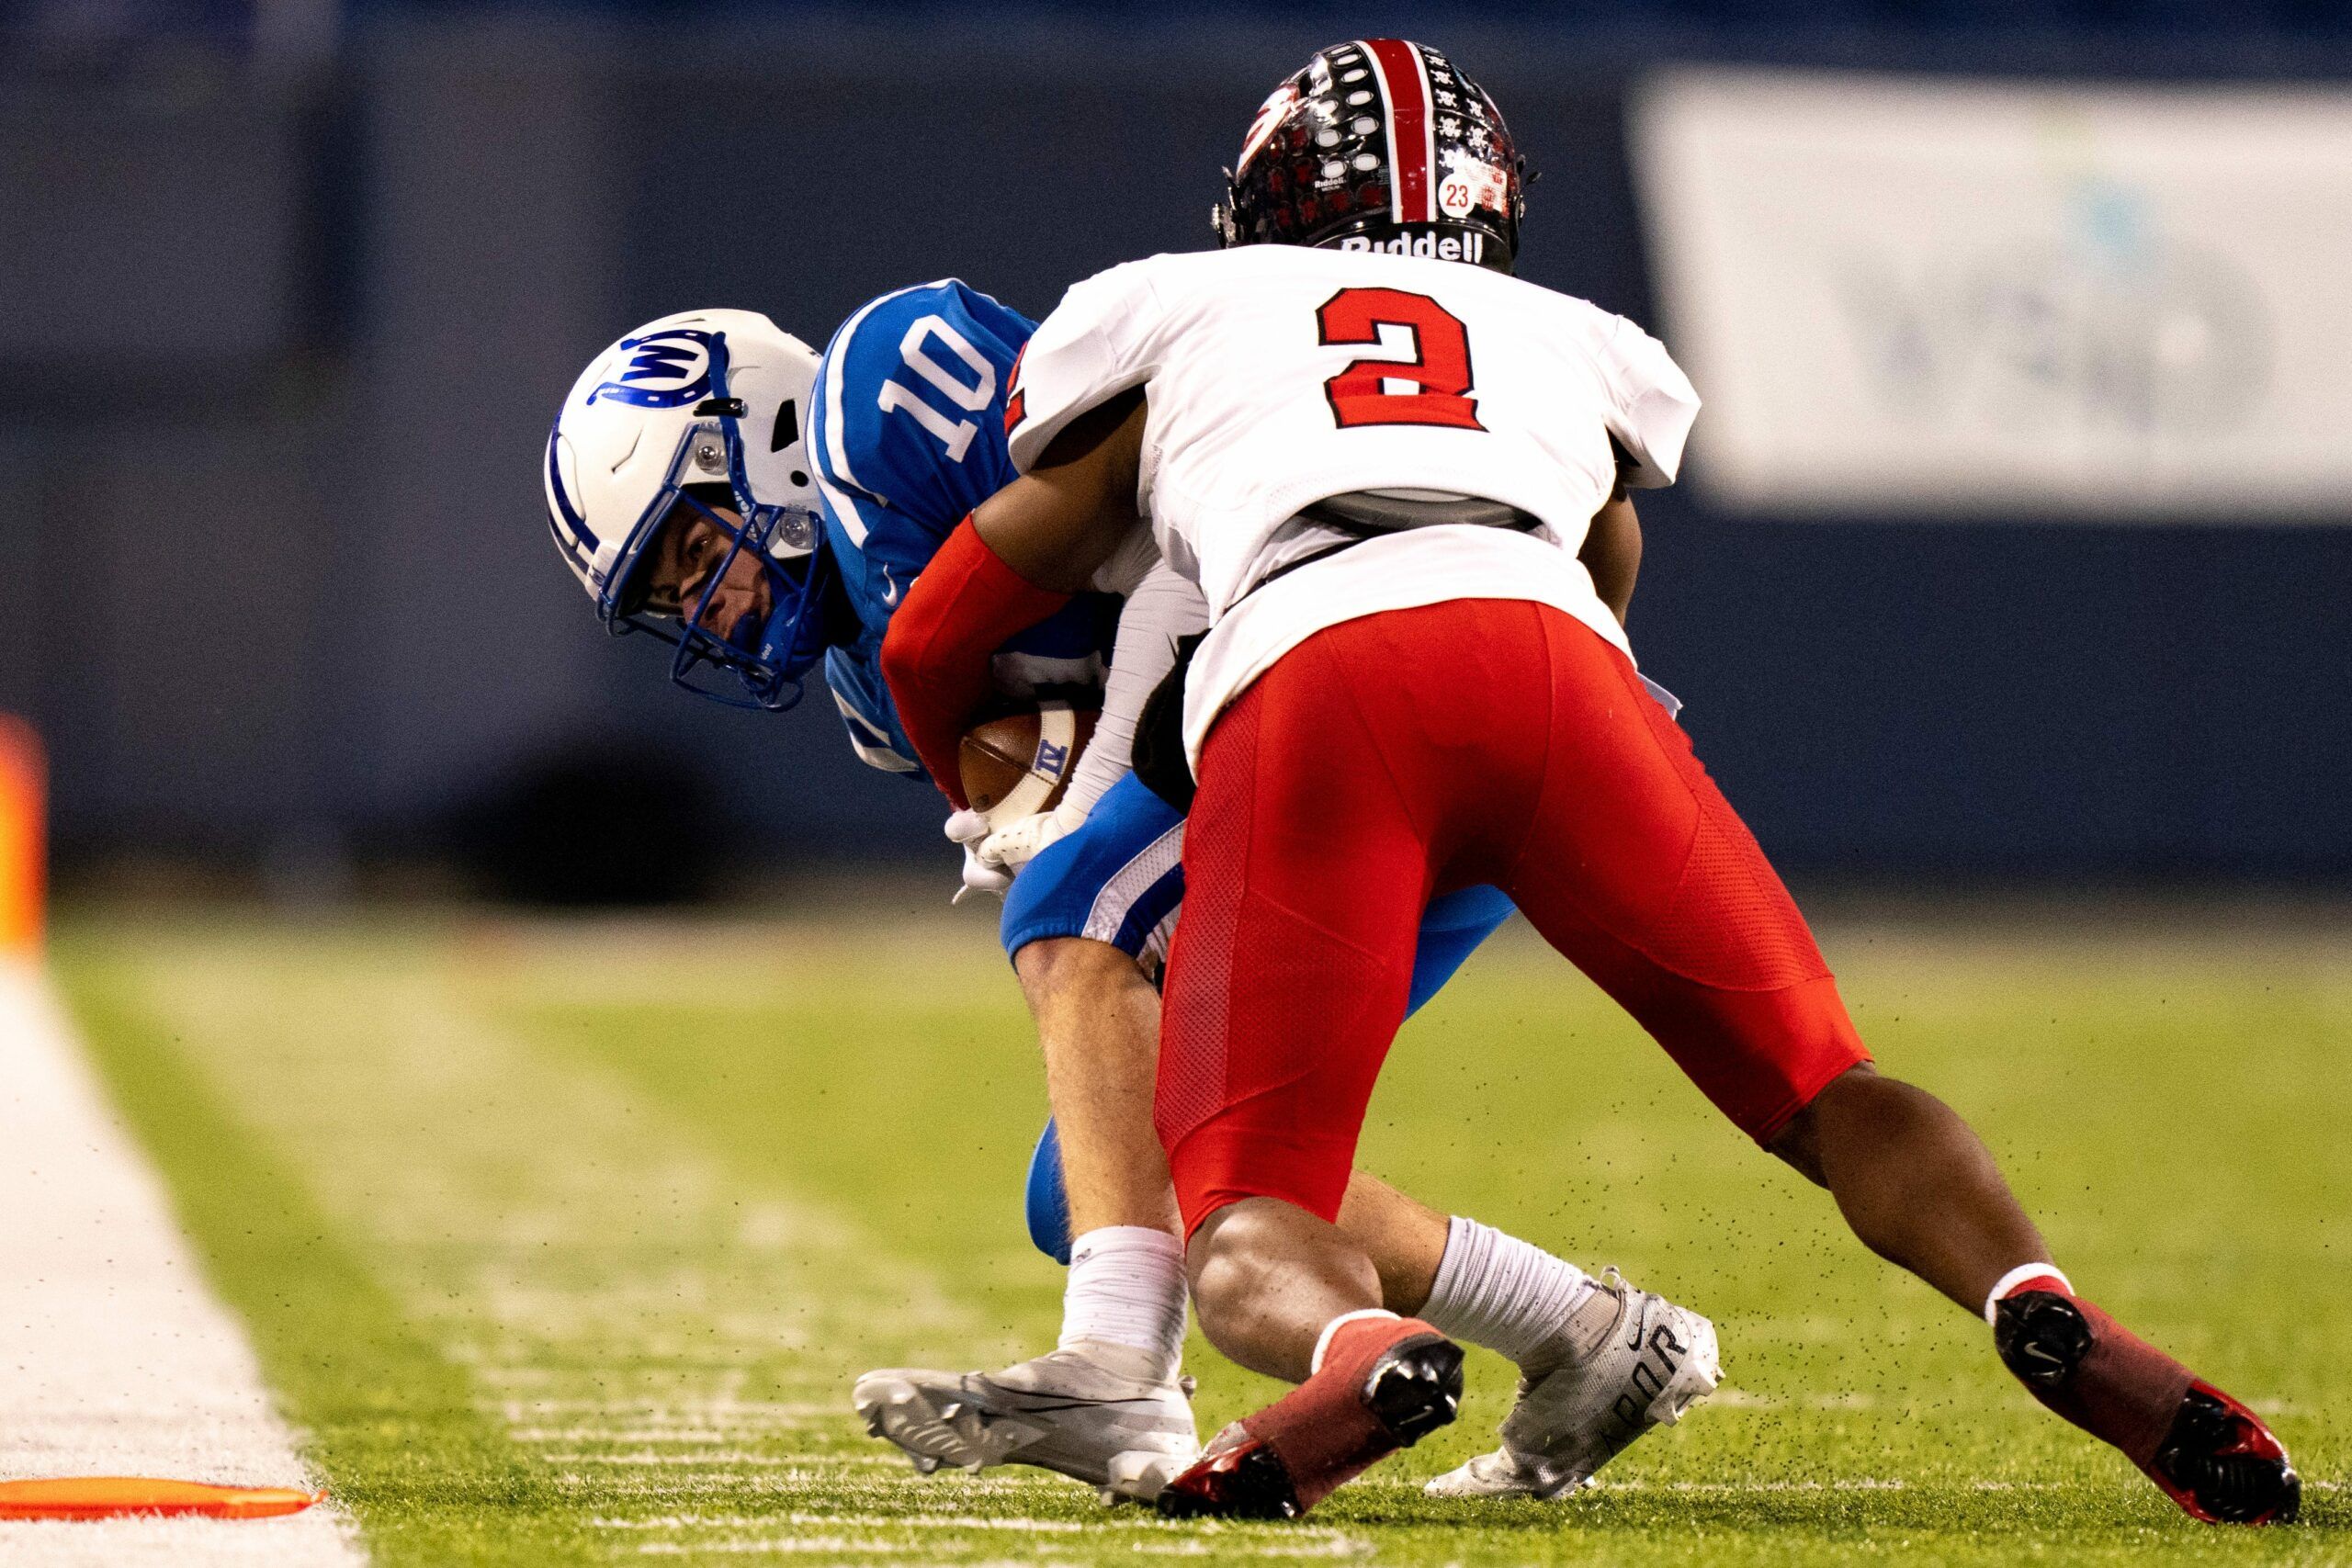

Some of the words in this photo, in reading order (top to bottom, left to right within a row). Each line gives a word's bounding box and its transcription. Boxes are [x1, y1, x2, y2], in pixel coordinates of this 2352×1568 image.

[1446, 184, 1469, 208] 23
[620, 344, 699, 382] W
[877, 314, 997, 464] 10
[1315, 286, 1489, 432] 2
